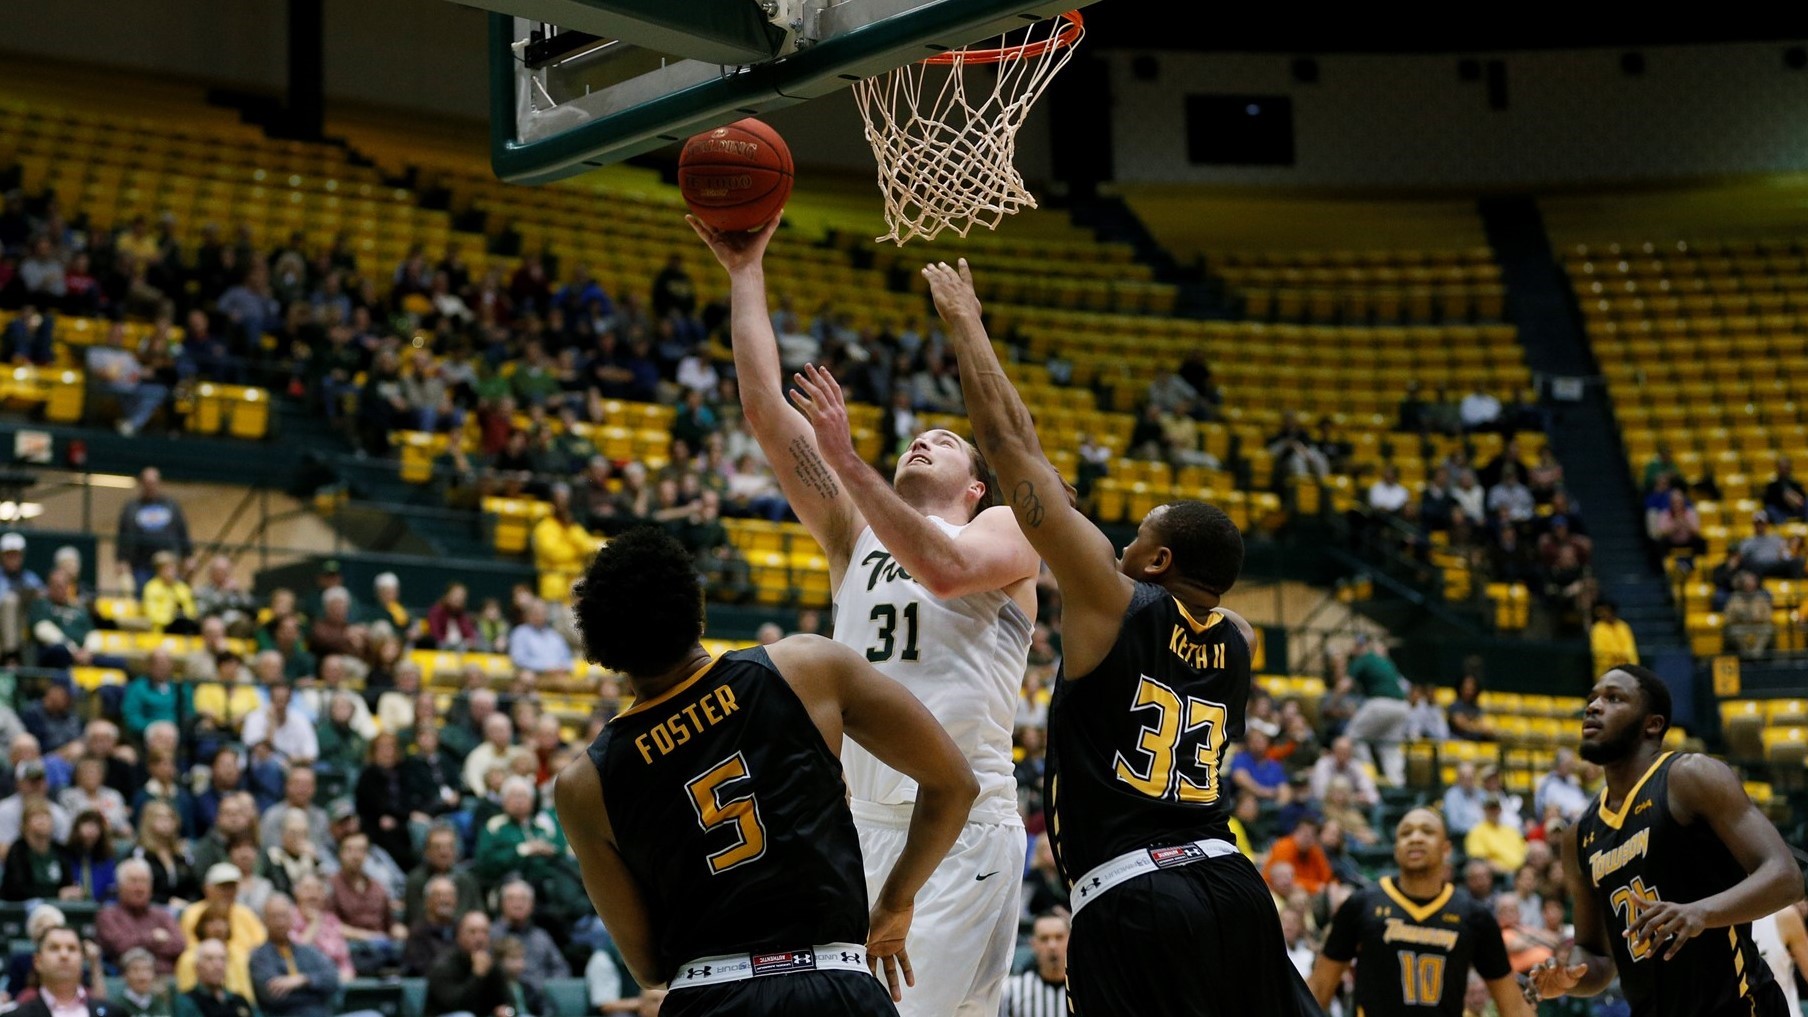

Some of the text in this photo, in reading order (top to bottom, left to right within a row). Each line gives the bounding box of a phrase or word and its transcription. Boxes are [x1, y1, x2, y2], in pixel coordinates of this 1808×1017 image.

[866, 602, 921, 663] 31
[634, 684, 740, 765] FOSTER
[1112, 673, 1228, 806] 33
[684, 750, 767, 876] 5
[1589, 826, 1650, 888] TOWSON
[1397, 949, 1447, 1006] 10
